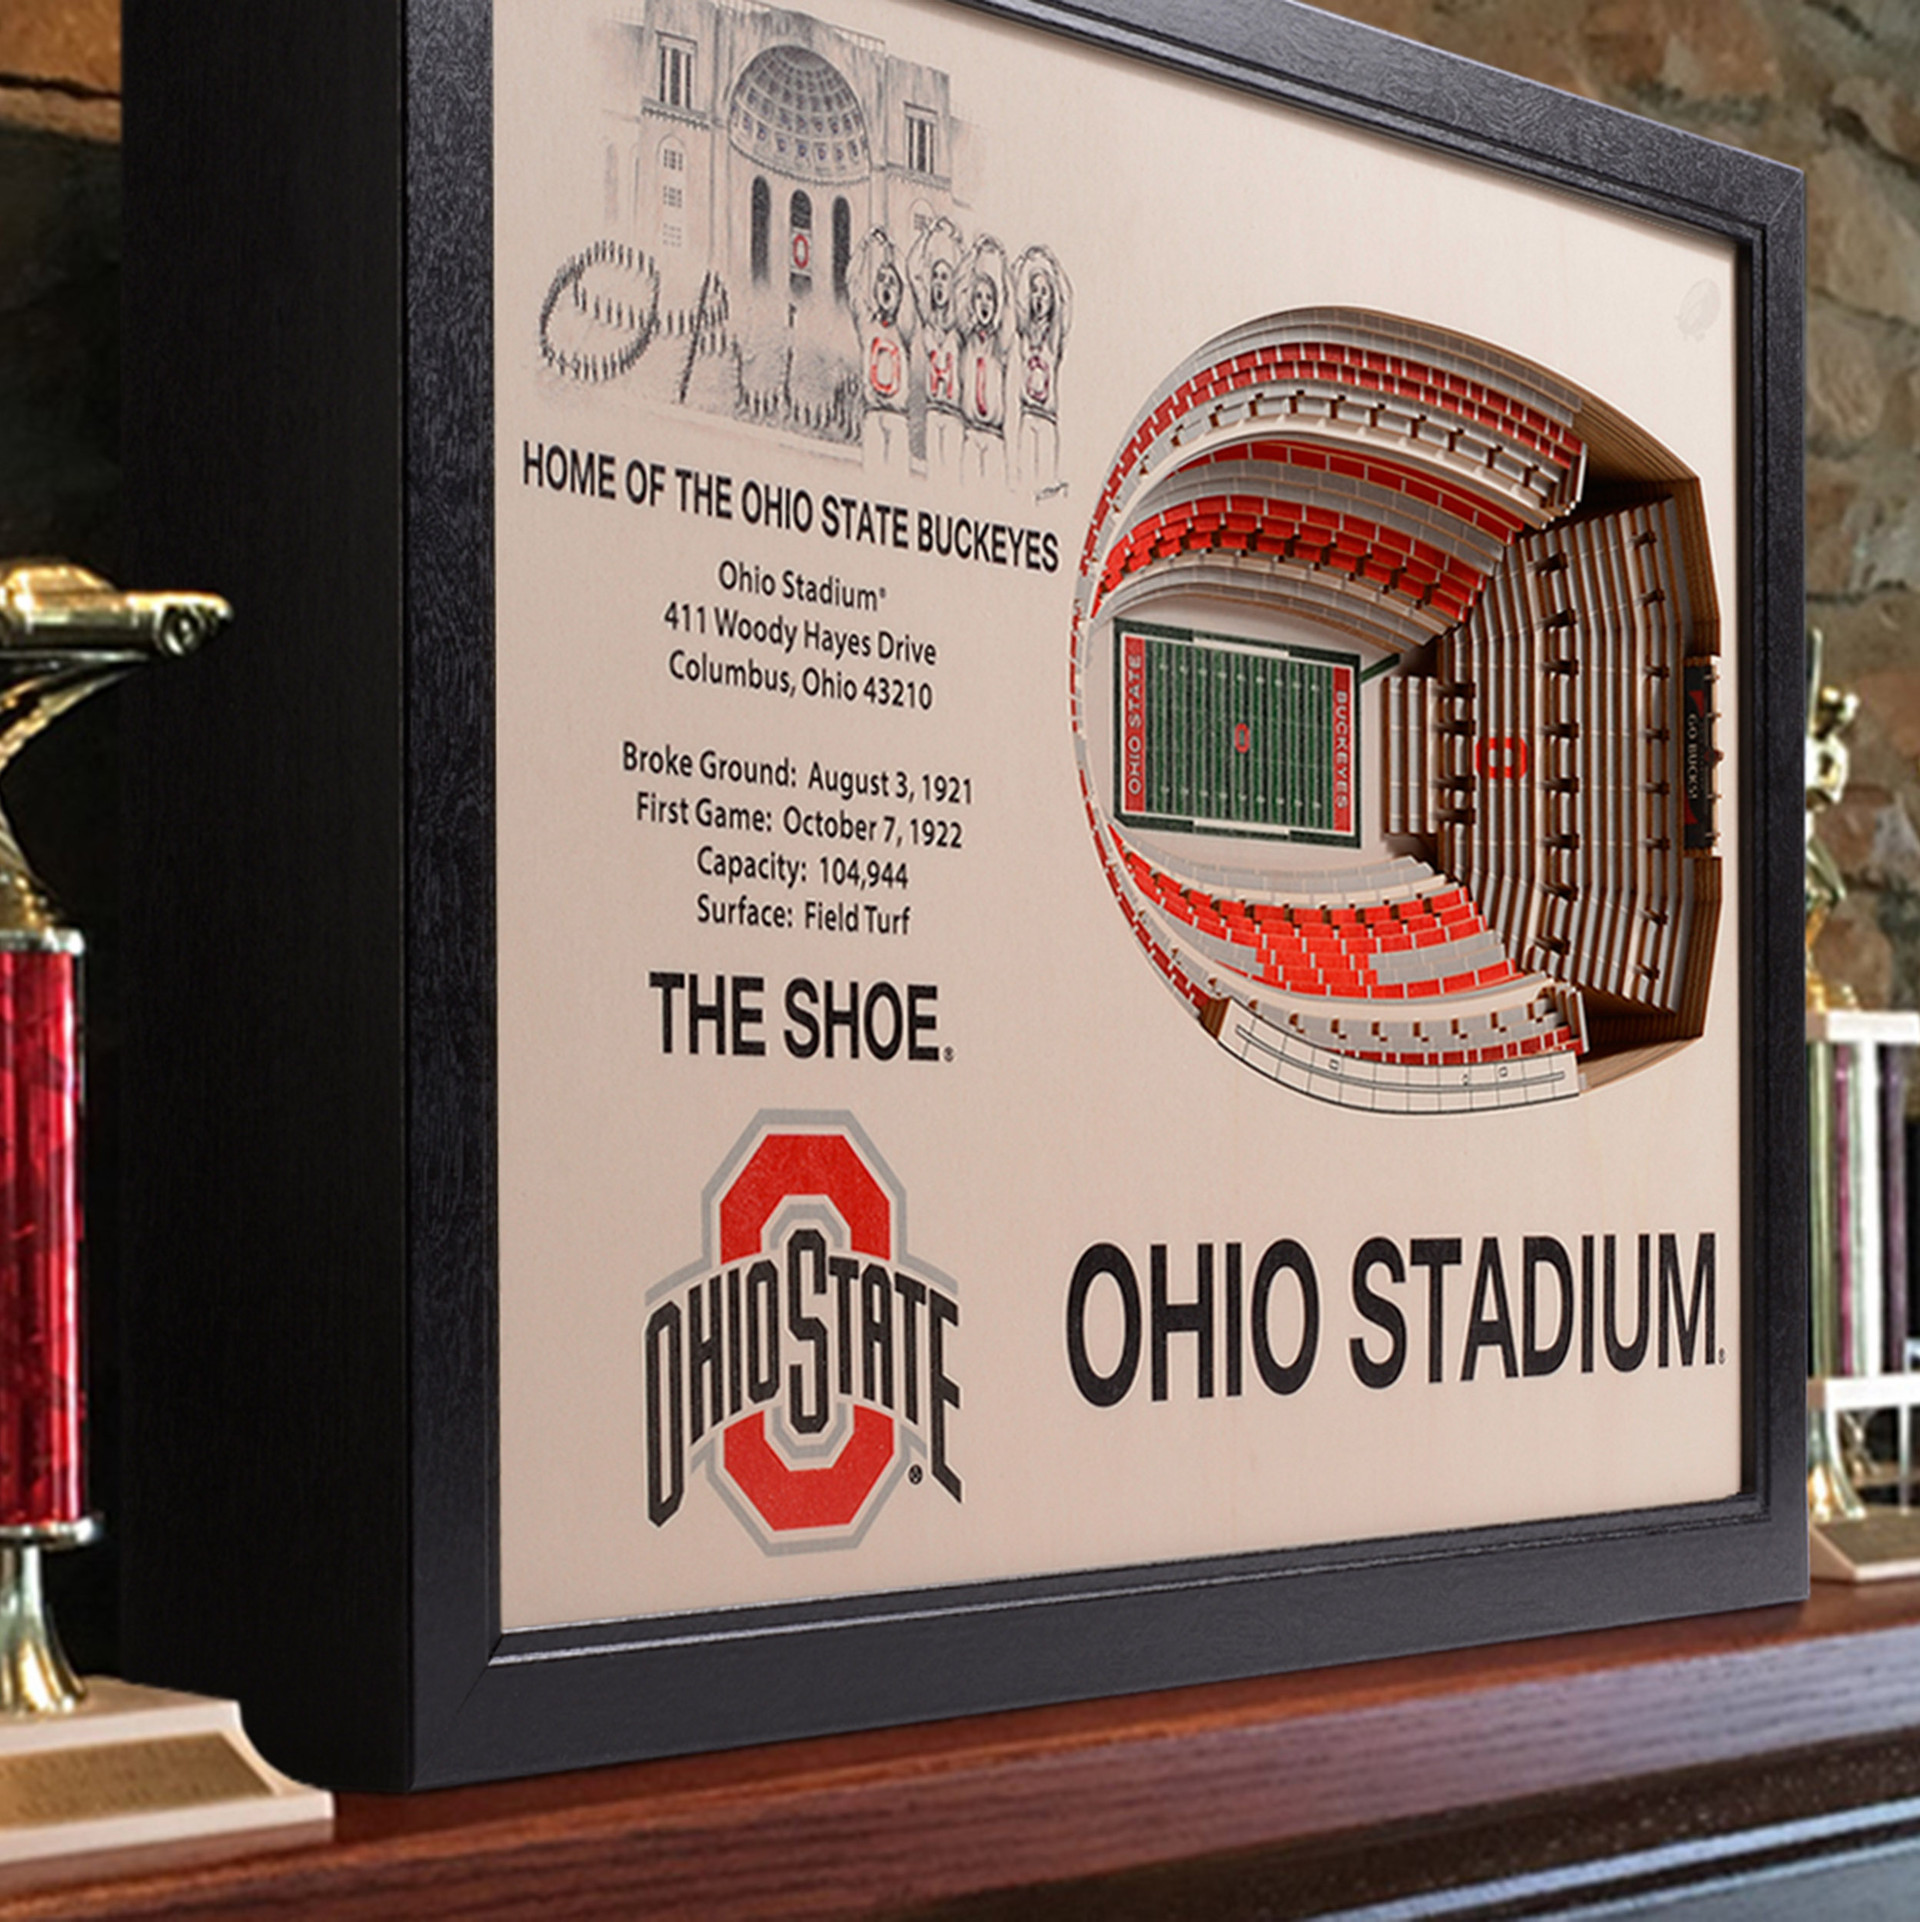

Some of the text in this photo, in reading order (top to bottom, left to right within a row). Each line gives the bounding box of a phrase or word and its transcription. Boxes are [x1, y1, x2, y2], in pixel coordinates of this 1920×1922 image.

[523, 440, 1059, 573] HOME OF THE OHIO STATE BUCKEYES
[718, 560, 776, 597] Ohio
[664, 601, 937, 666] 411 Woody Hayes Drive
[668, 648, 933, 711] Columbus, Ohio 43210
[1128, 654, 1141, 795] OHIO STATE
[1336, 690, 1348, 809] BUCKEYES
[622, 740, 972, 805] Broke Ground: August 3, 1921
[636, 790, 963, 849] First Game: October 7, 1922
[696, 845, 909, 891] Capacity: 104,944
[696, 892, 911, 936] Surface: Field Turf
[648, 971, 767, 1057] THE
[1065, 1238, 1320, 1408] OHIO
[645, 1228, 962, 1528] OHIO STATE
